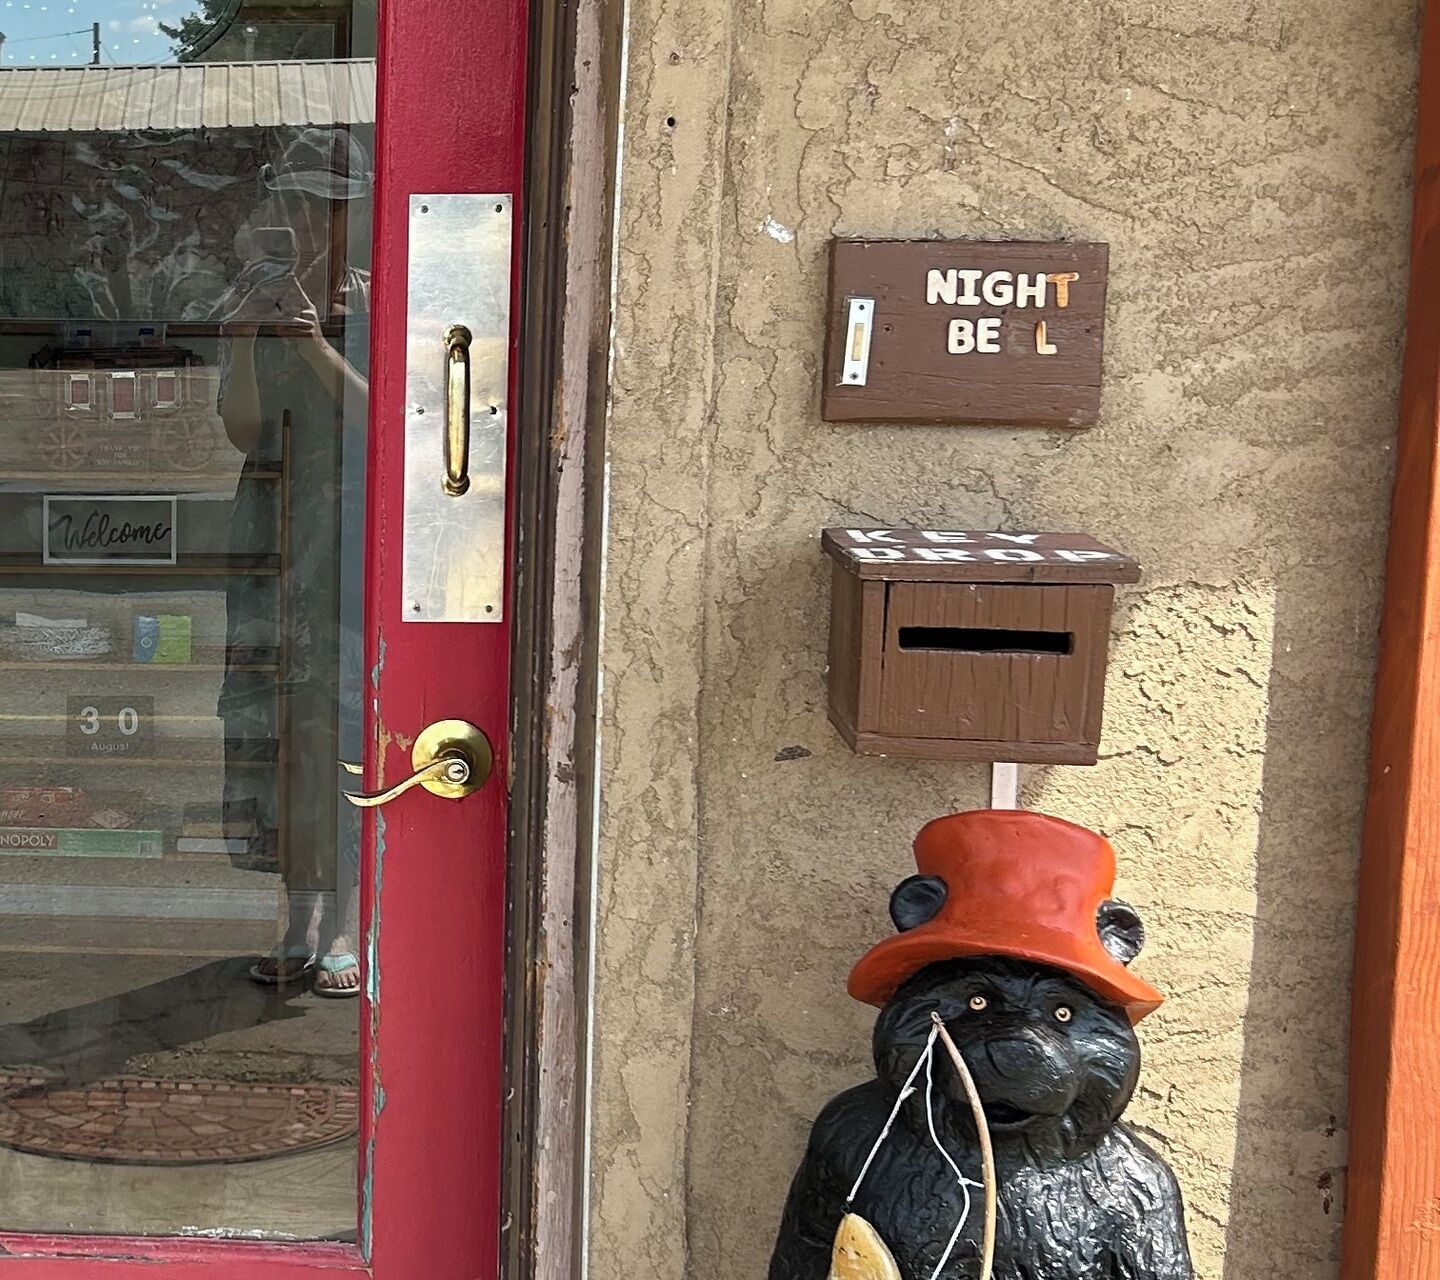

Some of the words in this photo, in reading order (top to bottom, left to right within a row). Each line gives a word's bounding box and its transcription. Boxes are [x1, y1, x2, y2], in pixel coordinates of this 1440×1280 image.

[926, 269, 1079, 308] NIGHT
[48, 510, 172, 551] Welcome
[846, 529, 1043, 545] KEY
[850, 547, 1114, 563] DROP
